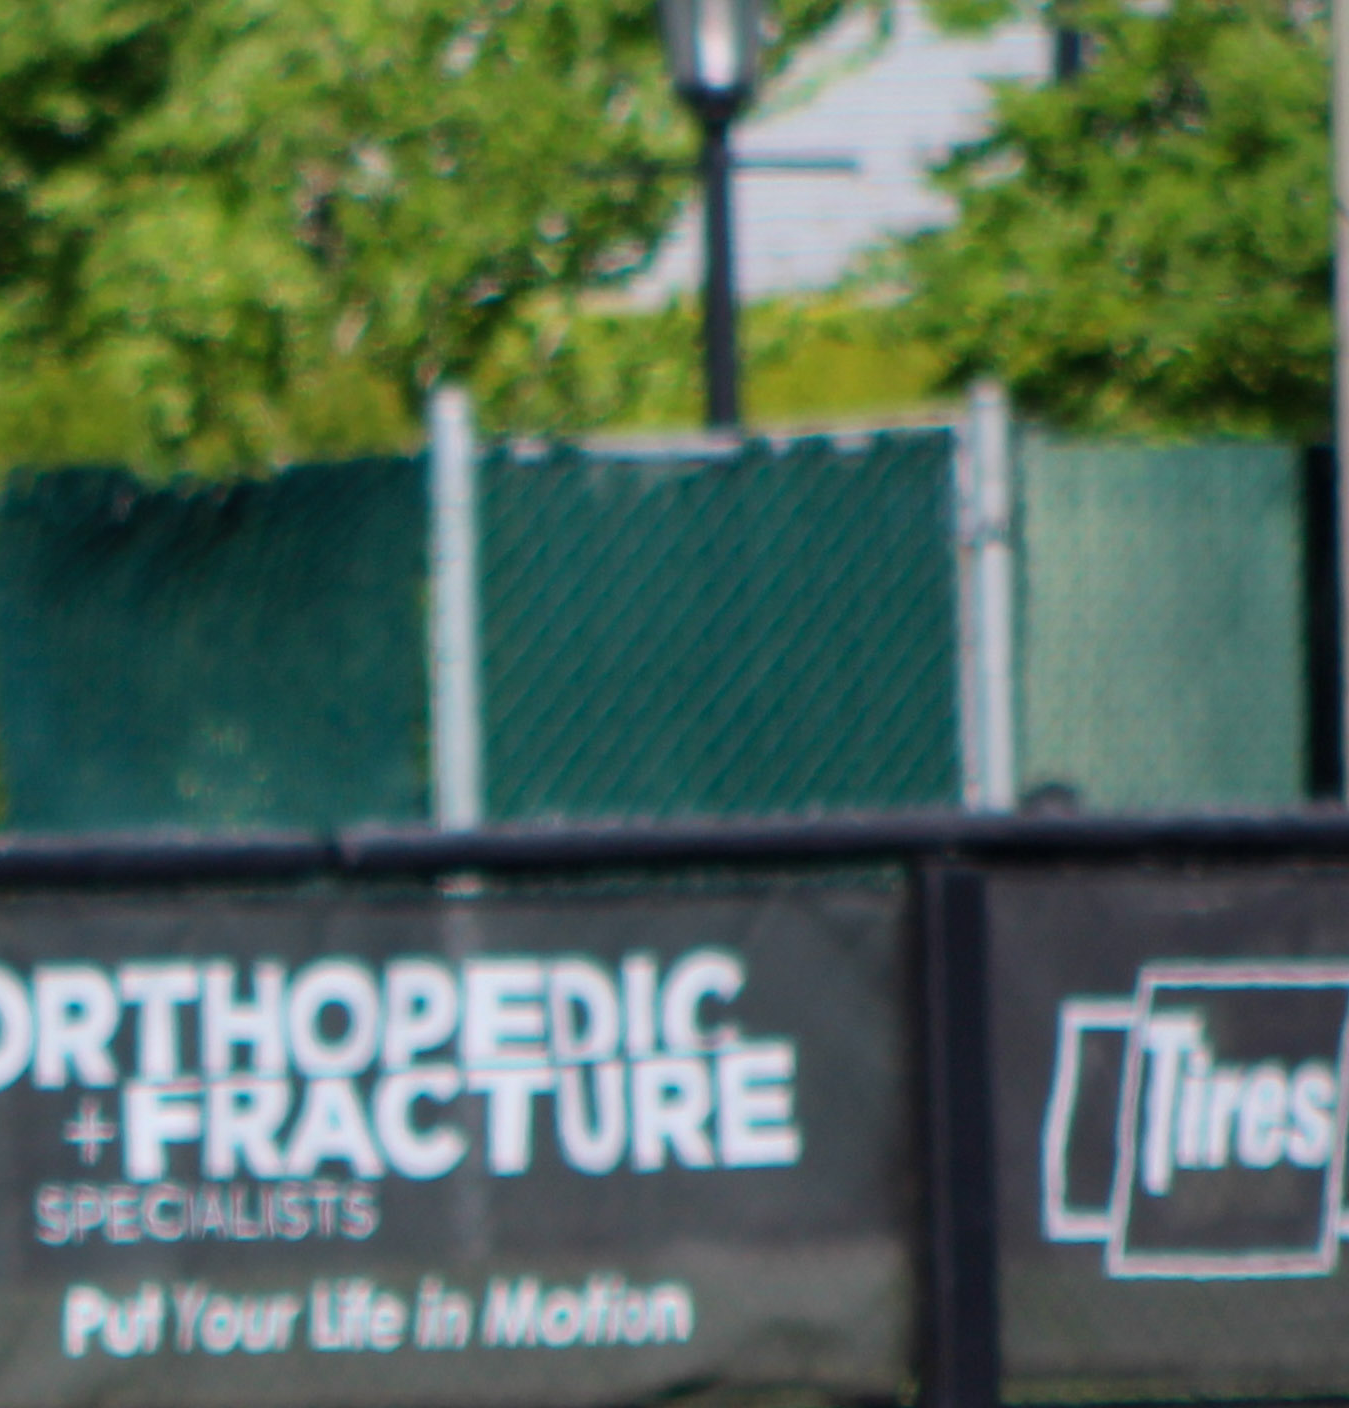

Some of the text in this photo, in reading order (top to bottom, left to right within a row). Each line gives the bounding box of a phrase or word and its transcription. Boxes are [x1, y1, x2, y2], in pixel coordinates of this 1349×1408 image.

[1139, 1008, 1335, 1197] Tires
[34, 1180, 381, 1246] SPECIALISTS
[62, 1272, 695, 1358] Put Your Life in Motion
